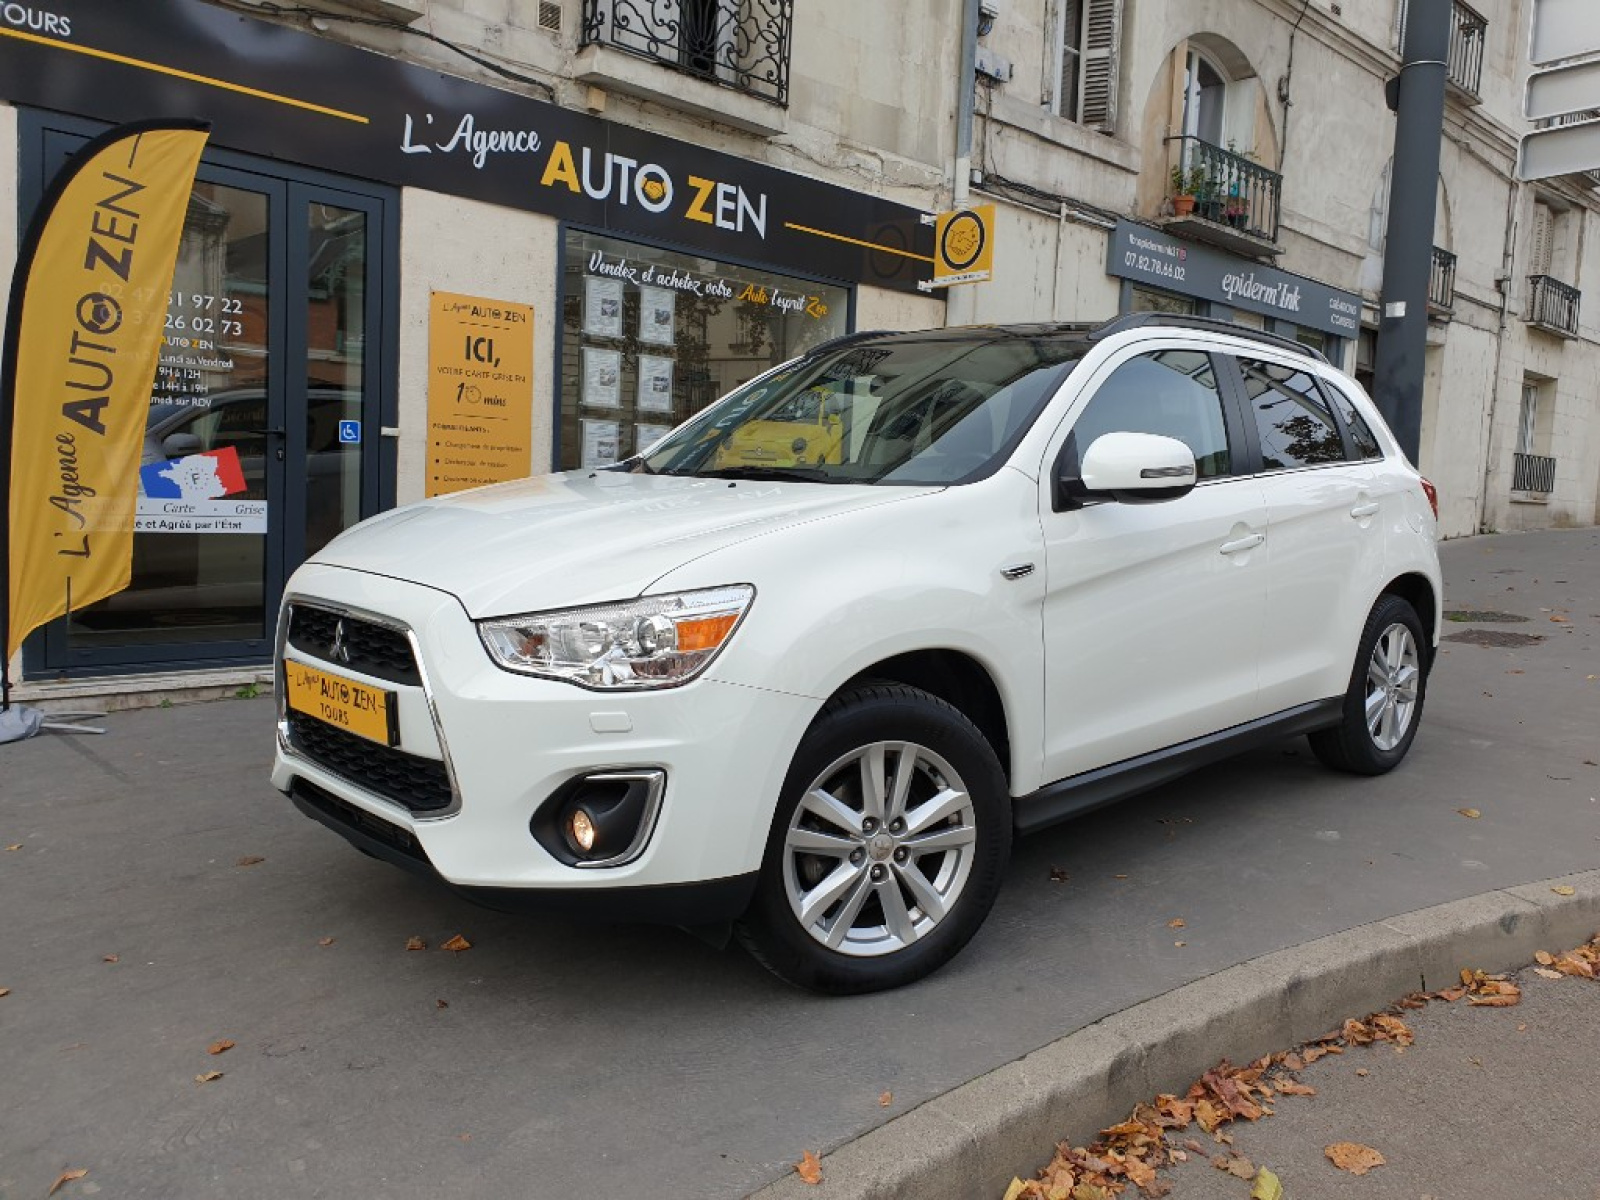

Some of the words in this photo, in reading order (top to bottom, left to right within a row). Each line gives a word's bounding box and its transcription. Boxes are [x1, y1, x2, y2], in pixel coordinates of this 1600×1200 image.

[540, 140, 673, 213] AUTO
[684, 174, 767, 240] ZEN
[84, 171, 147, 282] ZEN
[589, 249, 641, 286] Vendez
[641, 264, 656, 283] et
[656, 269, 704, 297] achetez
[705, 279, 732, 299] votre
[736, 283, 769, 304] Auto
[806, 296, 828, 319] Zen
[191, 294, 215, 310] 97
[221, 298, 243, 315] 22
[163, 313, 186, 329] 26
[191, 316, 215, 334] 02
[221, 320, 243, 336] 73
[503, 310, 527, 324] ZEN
[191, 338, 214, 350] ZEN
[464, 335, 501, 368] ICI,
[61, 291, 123, 436] AUTO
[185, 356, 196, 365] au
[196, 354, 235, 369] Vendredi
[183, 368, 201, 379] 12H
[150, 395, 172, 405] medi
[174, 398, 190, 407] sur
[191, 397, 213, 408] RDV
[191, 472, 200, 486] F
[162, 502, 197, 515] Carte
[235, 504, 265, 517] Grise
[145, 518, 158, 530] et
[194, 521, 213, 532] par
[352, 686, 377, 715] ZEN
[320, 702, 349, 726] TOURS
